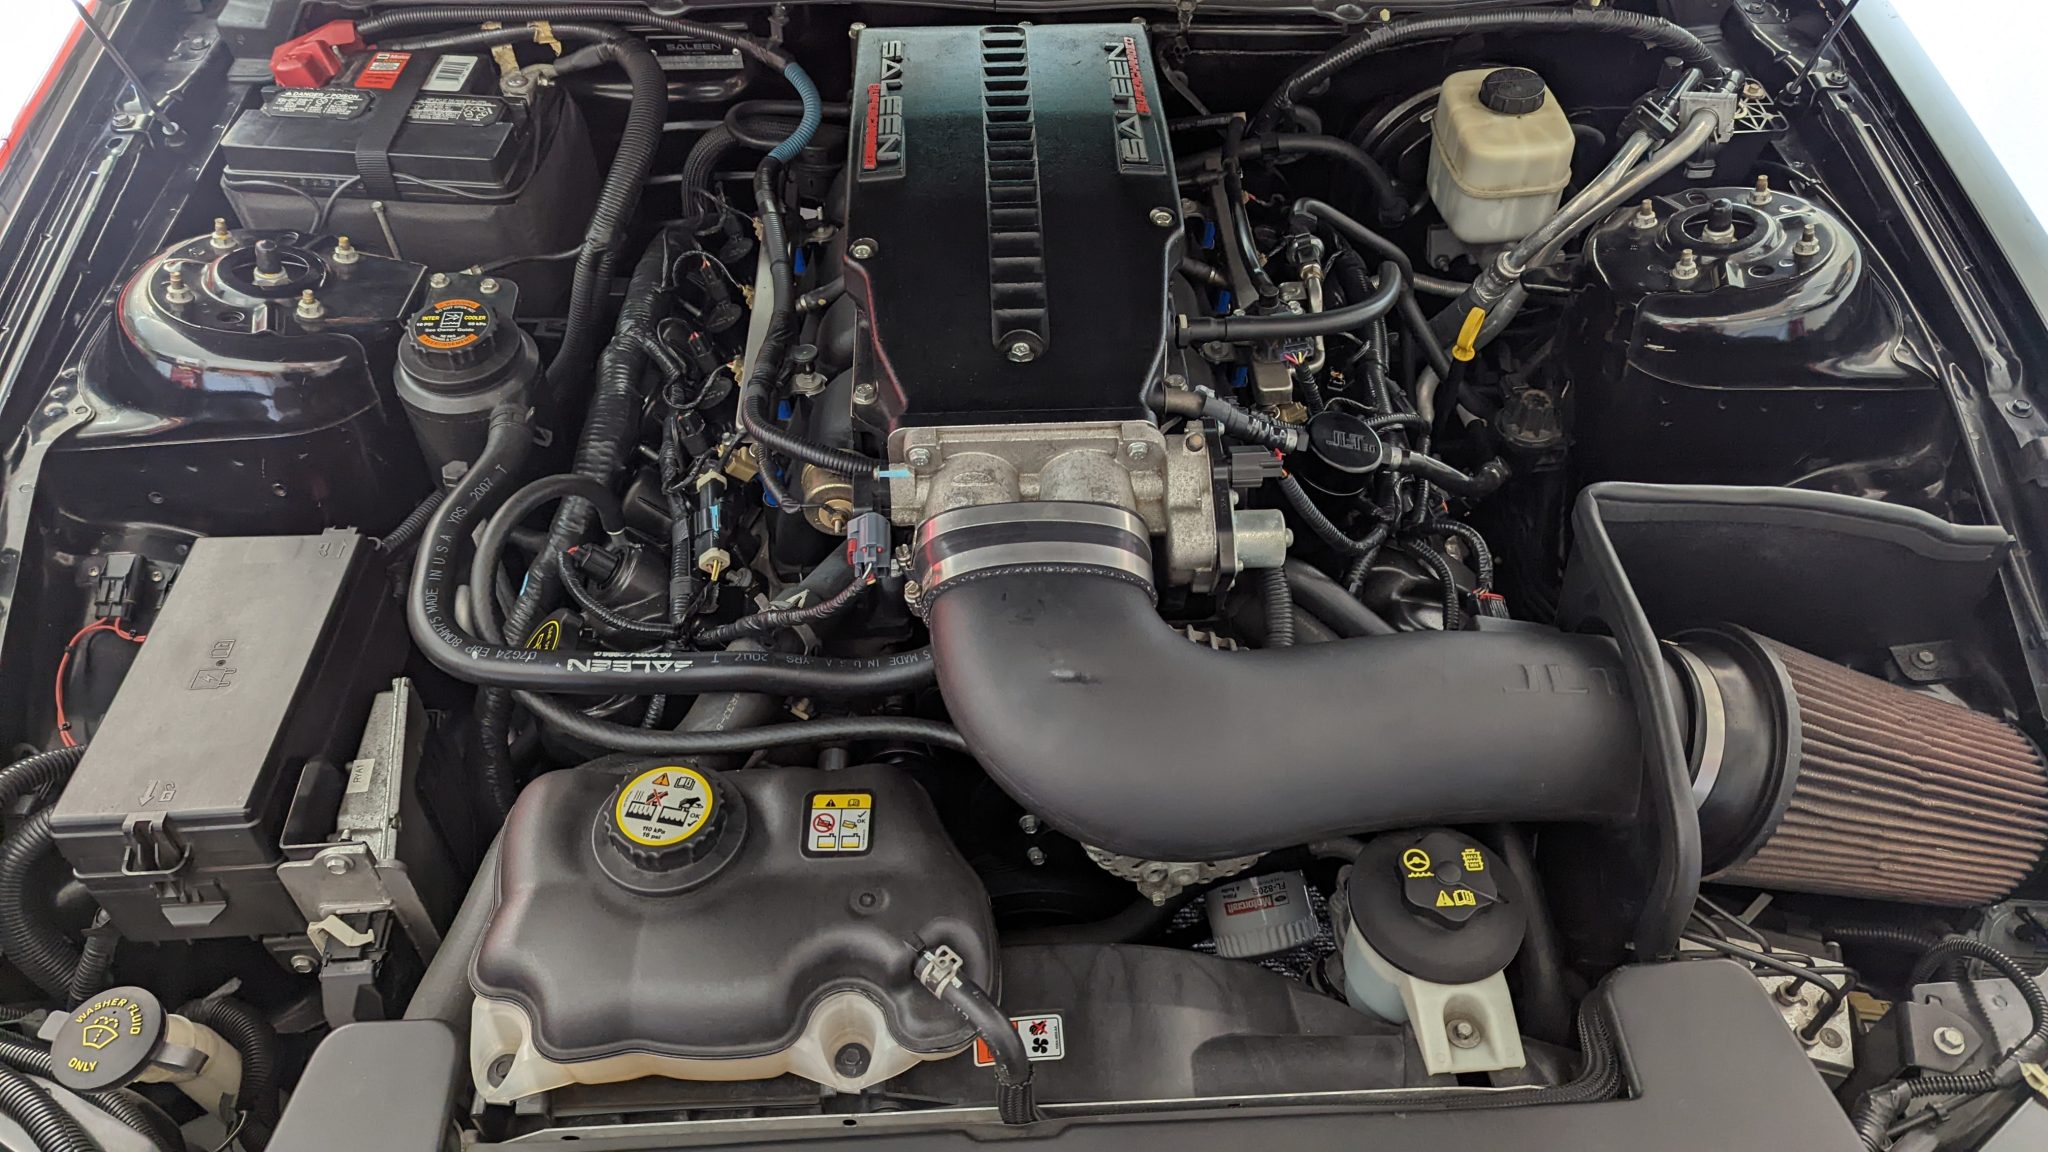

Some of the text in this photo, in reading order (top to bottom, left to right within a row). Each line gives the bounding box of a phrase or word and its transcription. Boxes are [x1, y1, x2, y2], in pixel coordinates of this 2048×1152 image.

[878, 40, 902, 160] SALEEN
[1105, 42, 1148, 162] SALEEN
[495, 463, 508, 475] T
[469, 476, 495, 502] 2007
[447, 506, 468, 525] YRS
[429, 569, 443, 581] IN
[425, 587, 439, 614] MADE
[566, 658, 694, 674] SALEEN
[786, 655, 810, 665] YRS
[867, 660, 881, 668] IN
[890, 655, 918, 667] MADE
[653, 826, 666, 835] kPa
[1226, 895, 1273, 913] Motorcraft
[75, 997, 143, 1036] WASHER FLUID
[67, 1057, 98, 1072] ONLY
